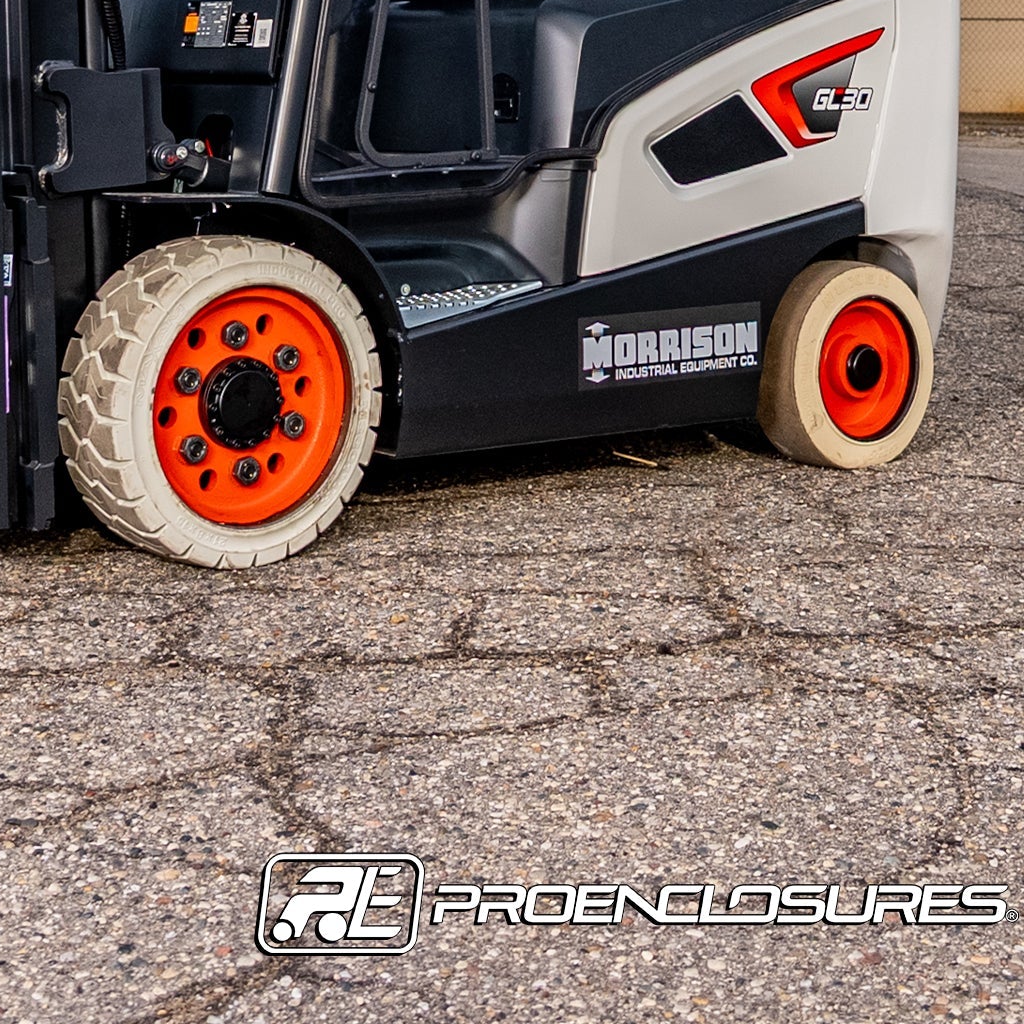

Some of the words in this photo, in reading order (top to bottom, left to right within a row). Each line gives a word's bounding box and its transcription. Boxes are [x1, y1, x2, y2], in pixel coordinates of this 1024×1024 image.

[812, 87, 874, 112] GL30
[257, 262, 325, 295] INDUSTRIAL
[583, 321, 758, 370] MORRISON
[615, 363, 678, 380] INDUSTRIAL
[680, 355, 739, 373] EQUIPMENT
[739, 354, 758, 367] CO.
